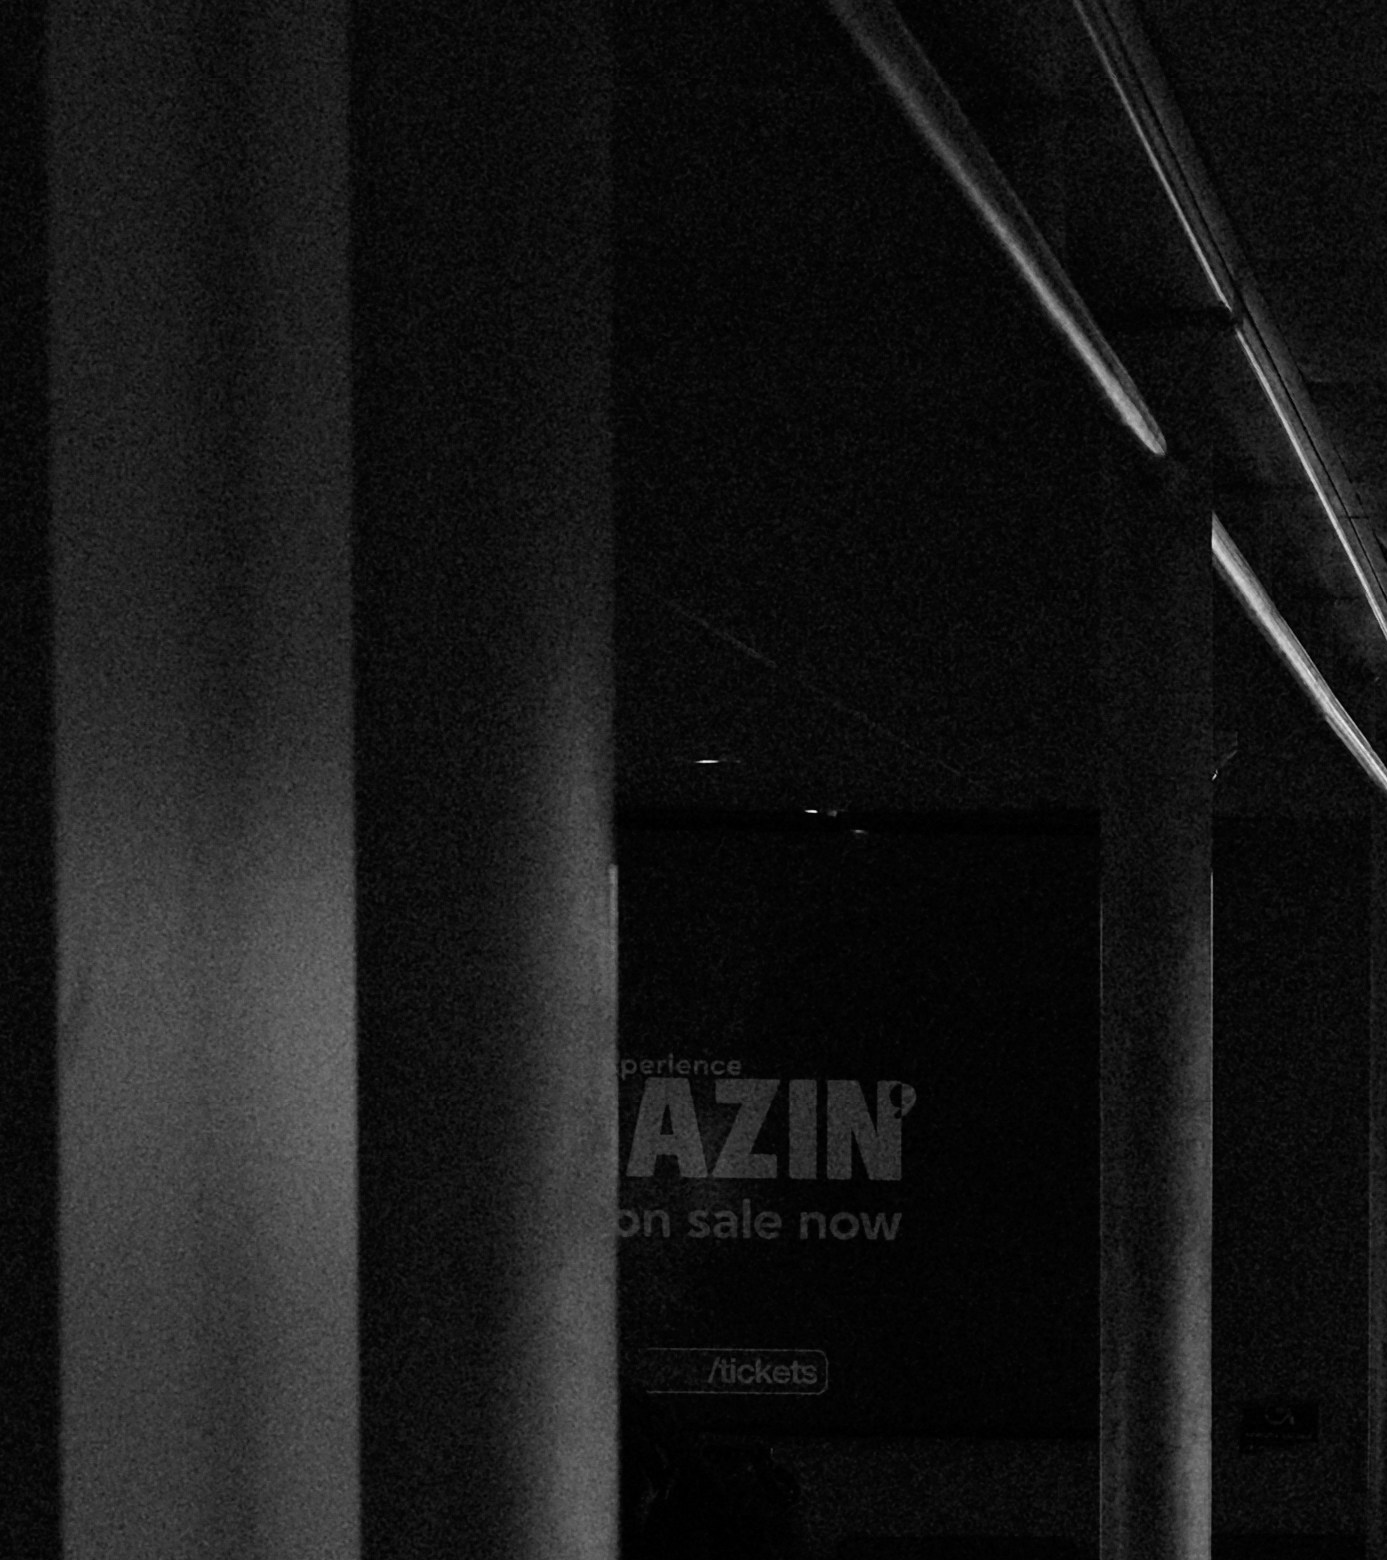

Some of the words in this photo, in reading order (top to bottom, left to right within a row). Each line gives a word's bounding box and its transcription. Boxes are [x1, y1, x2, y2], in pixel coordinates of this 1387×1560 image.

[619, 1053, 742, 1081] perience
[617, 1209, 671, 1239] on
[688, 1198, 783, 1240] sale
[800, 1210, 903, 1241] now
